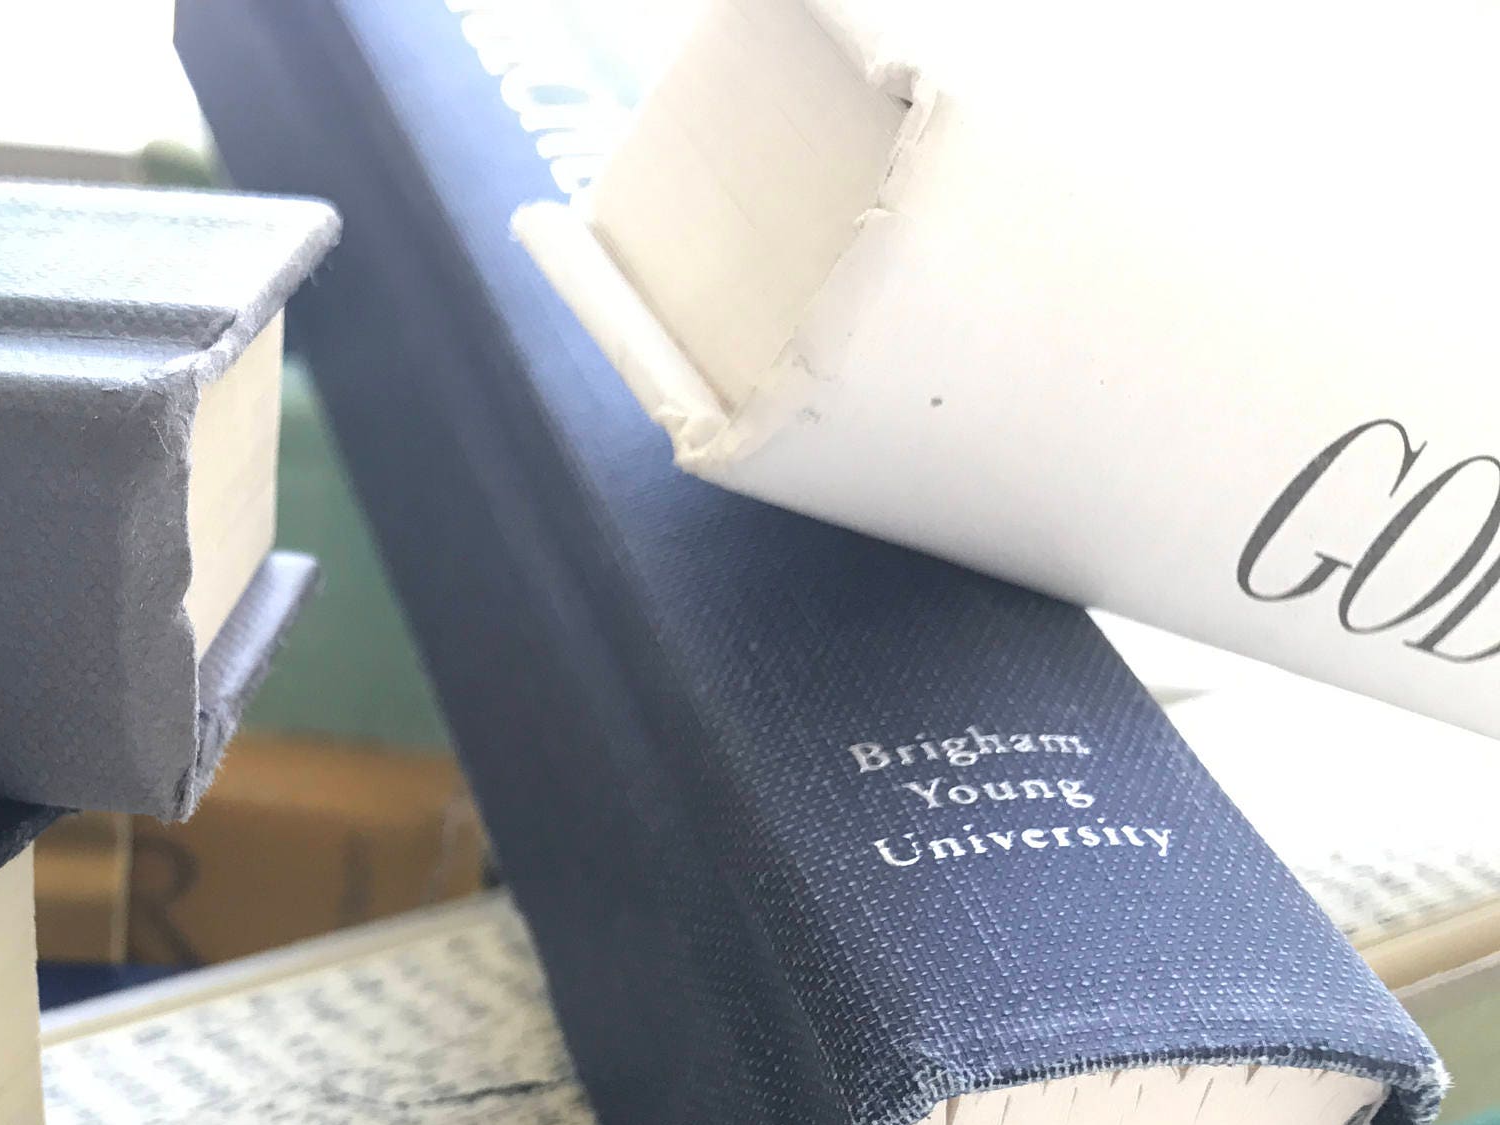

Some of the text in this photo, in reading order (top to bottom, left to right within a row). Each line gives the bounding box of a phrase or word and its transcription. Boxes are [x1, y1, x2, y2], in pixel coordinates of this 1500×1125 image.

[847, 724, 1093, 774] Brigham
[901, 776, 1096, 809] Young
[871, 816, 1173, 868] University
